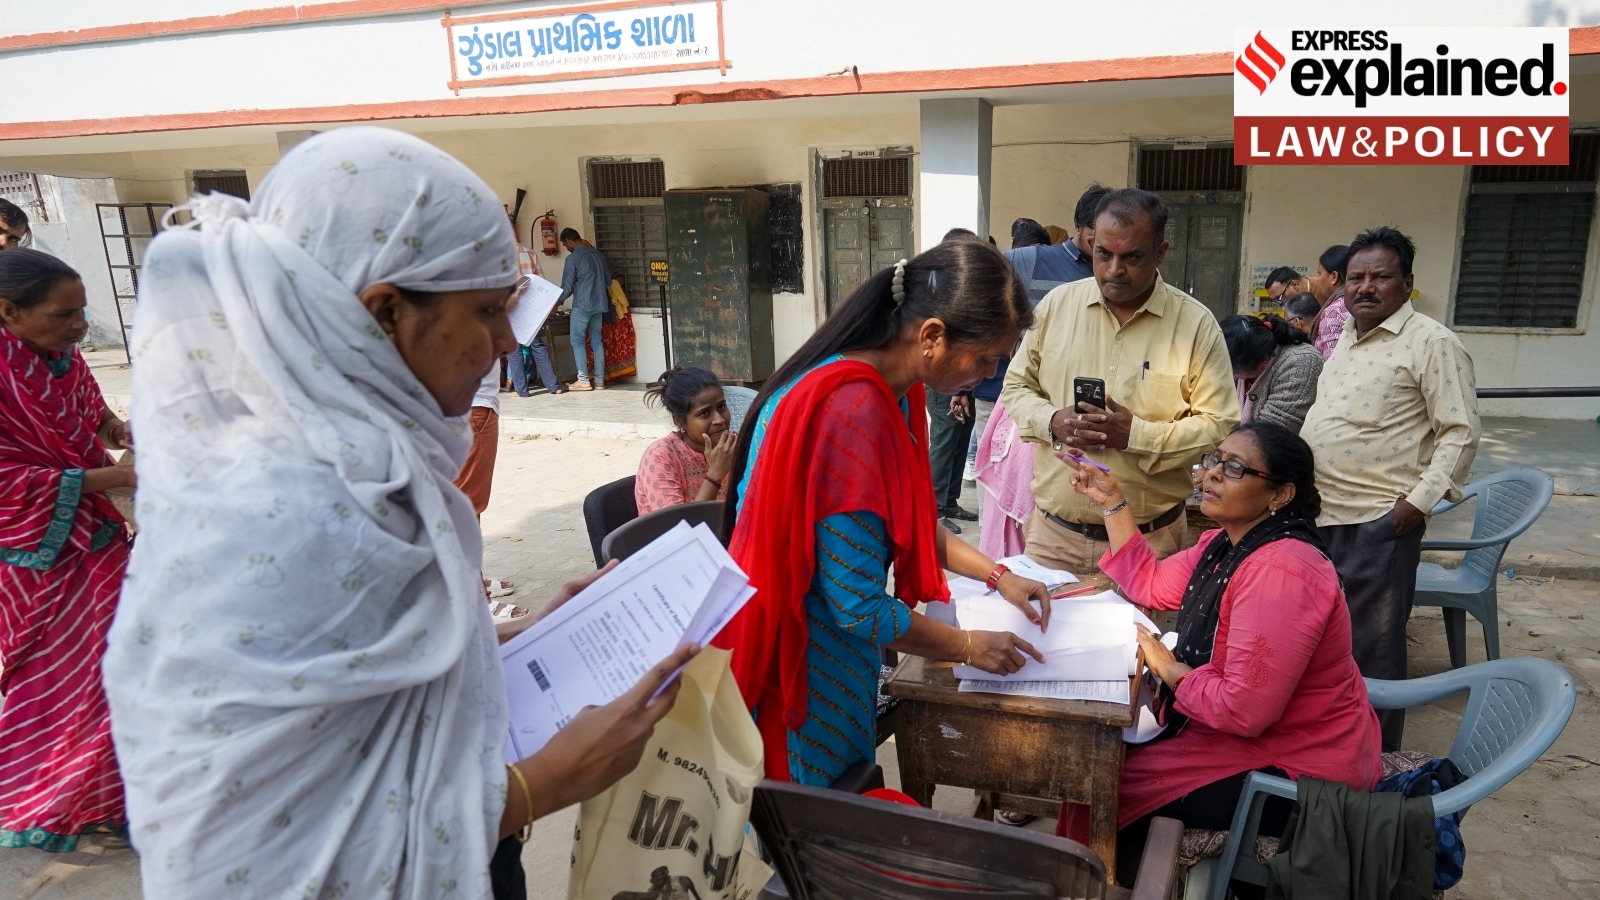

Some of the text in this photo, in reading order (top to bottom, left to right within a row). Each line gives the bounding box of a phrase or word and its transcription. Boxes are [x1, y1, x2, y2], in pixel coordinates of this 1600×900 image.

[458, 13, 695, 76] ઝુંડાલ પ્રાથમિક શાળા
[657, 747, 670, 764] M.
[627, 790, 701, 857] Mr.
